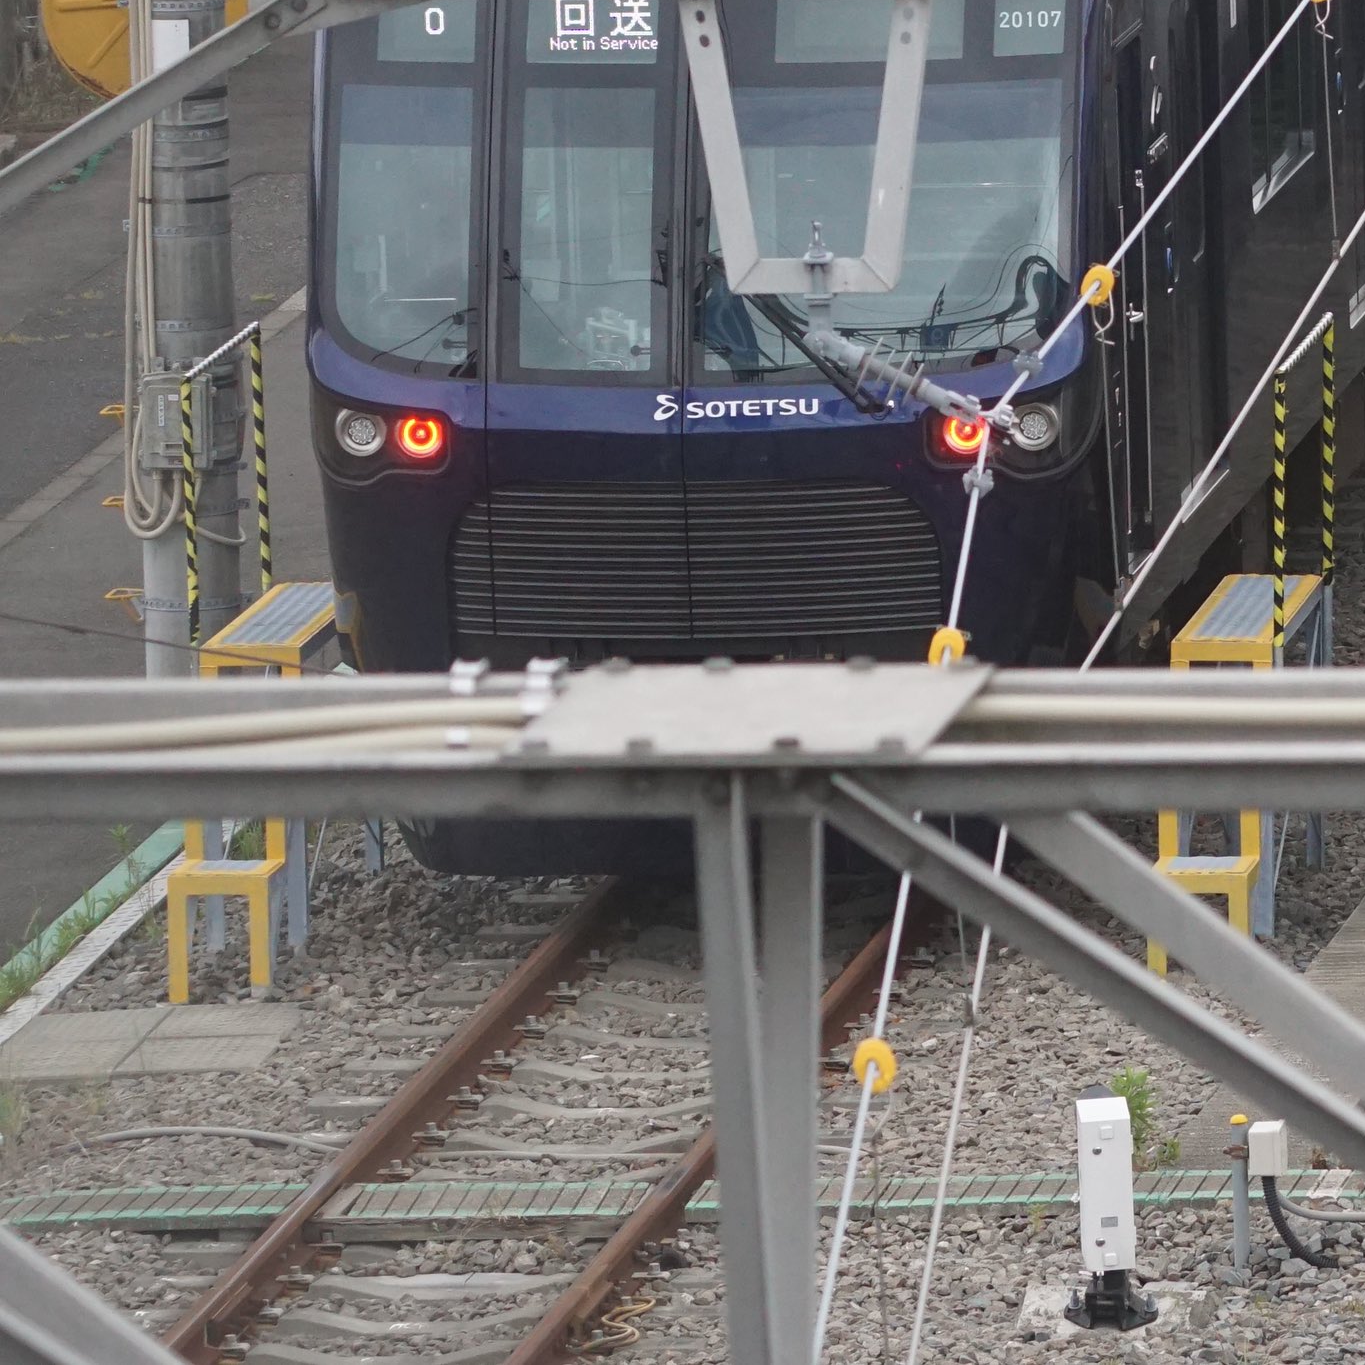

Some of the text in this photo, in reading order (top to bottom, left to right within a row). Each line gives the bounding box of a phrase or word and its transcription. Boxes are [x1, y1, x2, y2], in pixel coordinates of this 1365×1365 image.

[424, 7, 445, 35] 0
[999, 10, 1062, 29] 20107
[550, 36, 659, 51] Not in Service
[686, 398, 819, 419] SOTETSU
